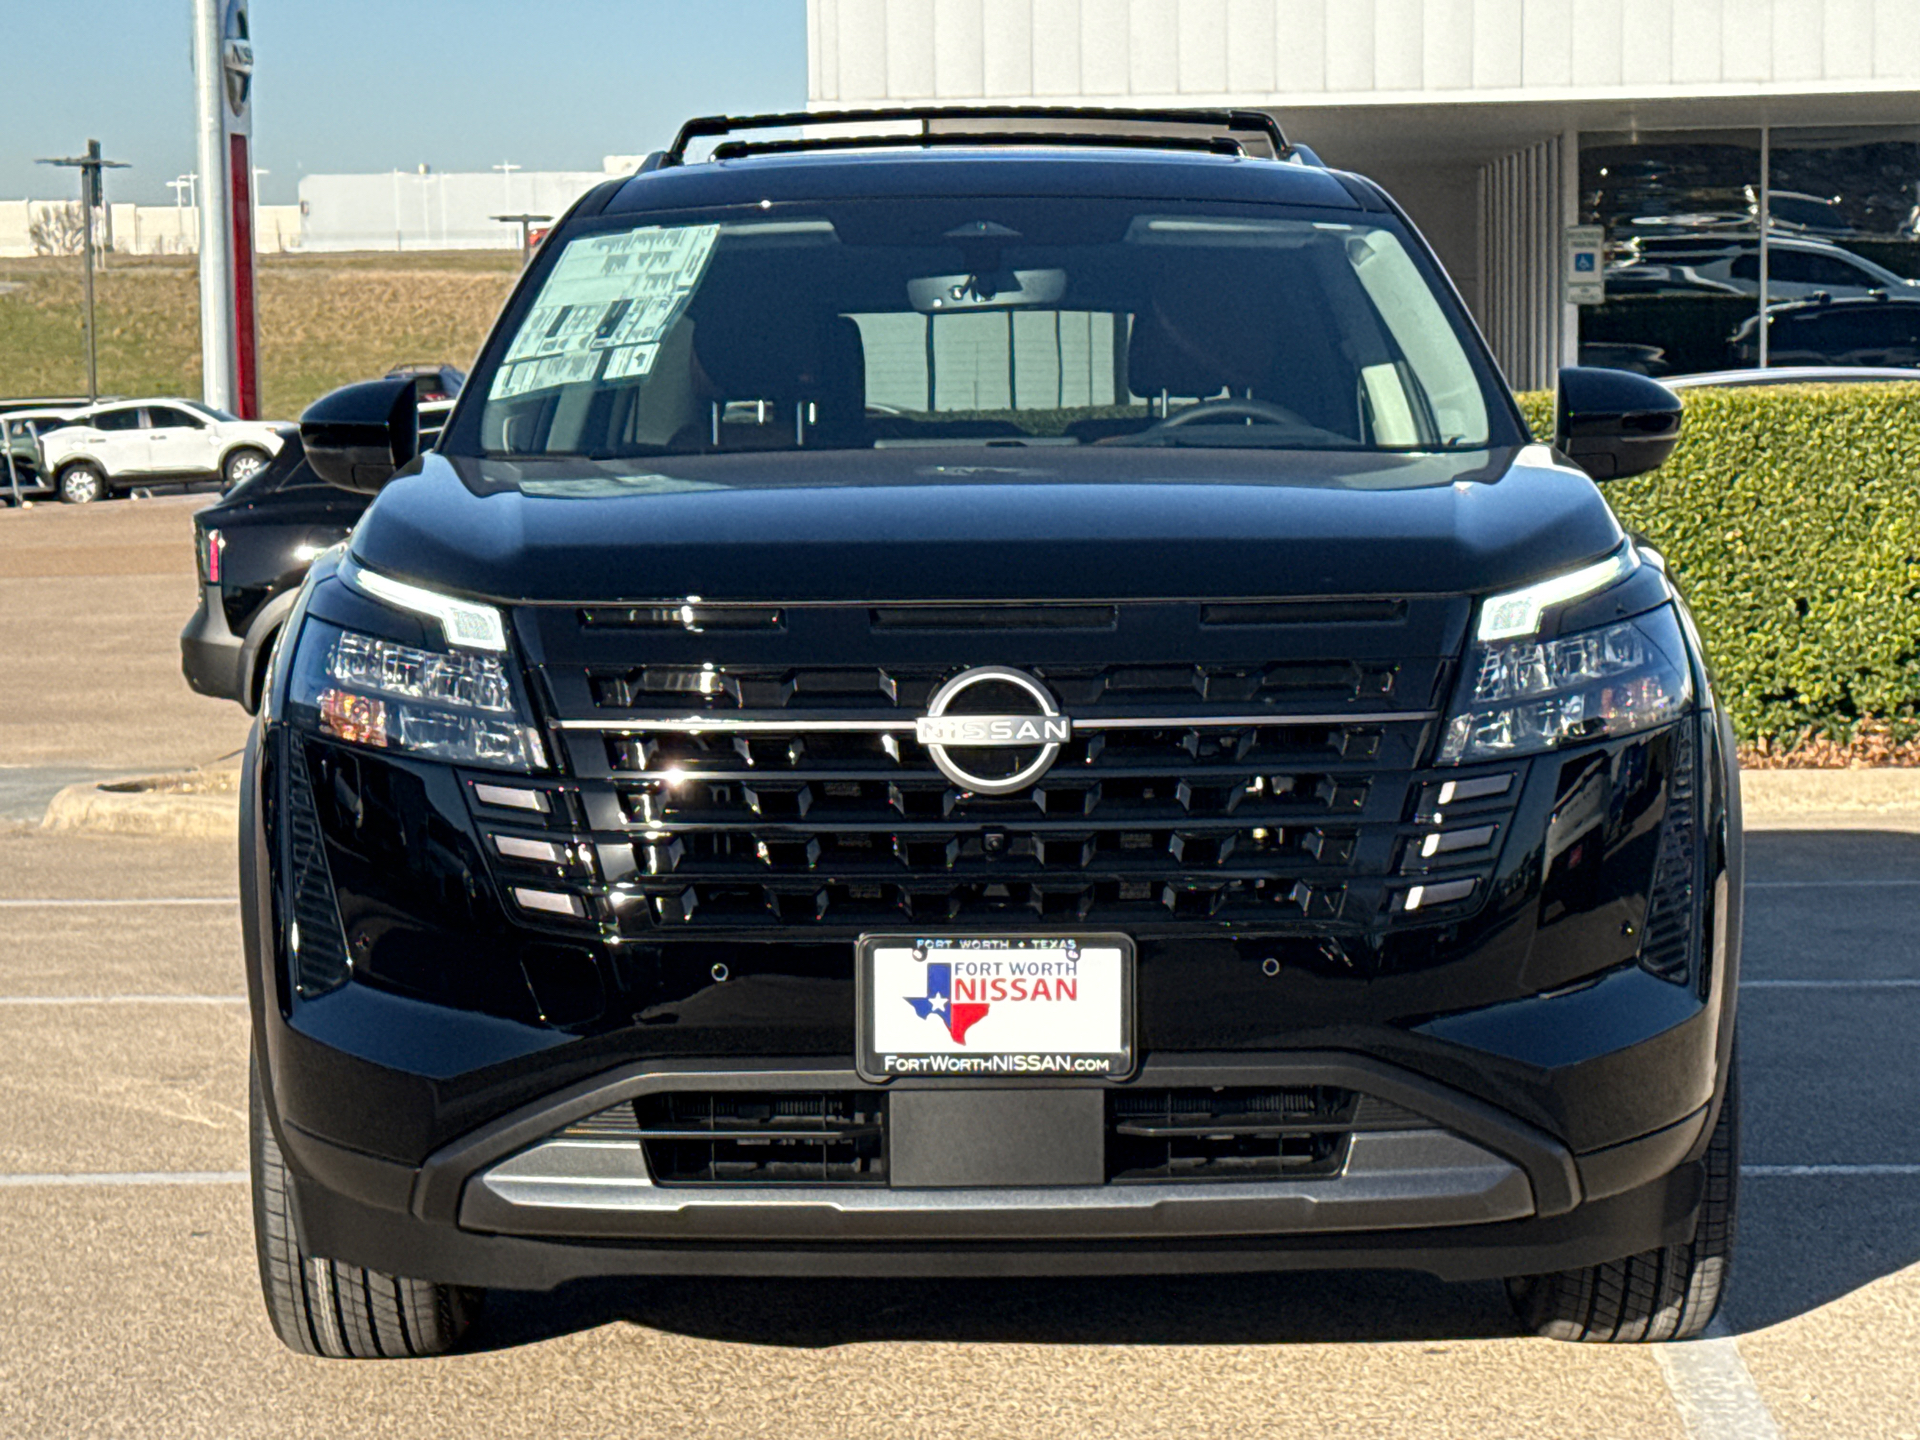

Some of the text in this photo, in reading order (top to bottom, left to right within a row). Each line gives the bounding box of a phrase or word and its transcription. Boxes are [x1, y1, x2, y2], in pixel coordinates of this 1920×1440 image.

[922, 720, 1067, 739] NISSAN
[916, 939, 1077, 949] FORT WORTH TEXAS
[954, 962, 1077, 976] FORT WORTH
[954, 978, 1077, 1001] NISSAN
